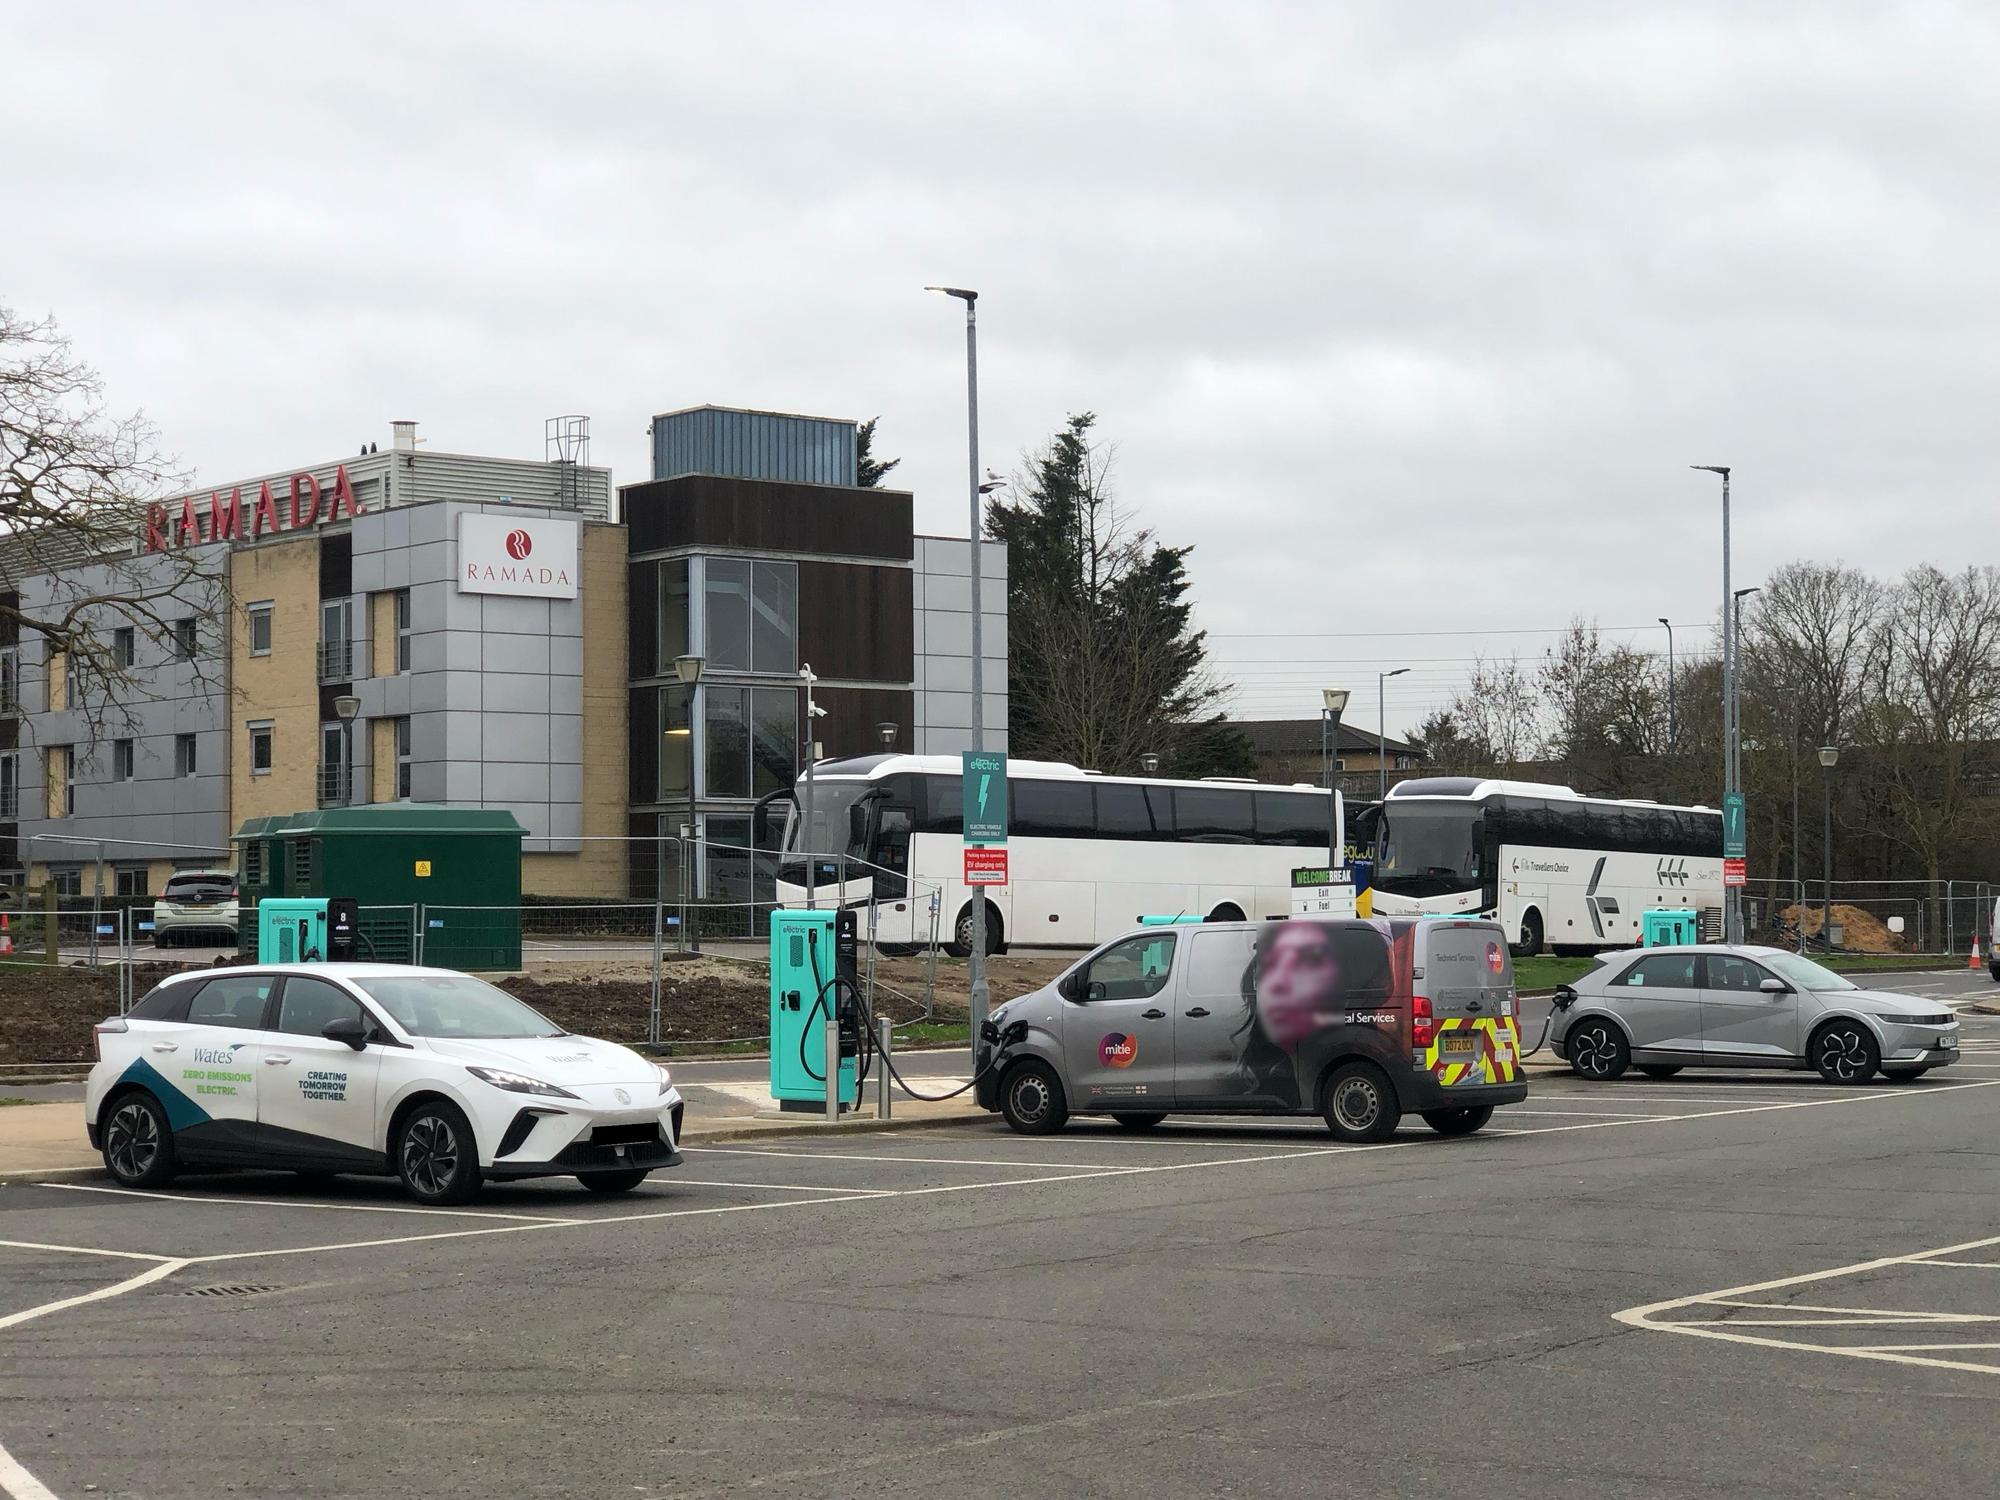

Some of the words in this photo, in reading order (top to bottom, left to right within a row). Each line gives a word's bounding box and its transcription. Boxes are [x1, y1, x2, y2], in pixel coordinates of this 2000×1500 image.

[147, 464, 357, 551] RAMADA
[467, 563, 568, 585] RAMADA
[970, 757, 1000, 770] electric
[1530, 861, 1554, 871] Travellers
[1554, 862, 1569, 872] Choice
[1296, 870, 1351, 884] WELCOMEBREAK
[1319, 888, 1329, 897] Exit
[1319, 901, 1330, 910] Fuel
[782, 925, 806, 934] electric
[1356, 1012, 1396, 1023] Services
[1105, 1043, 1131, 1055] mitie
[194, 1048, 233, 1064] Wates
[183, 1070, 205, 1079] ZERO
[207, 1071, 252, 1082] EMISSIONS
[308, 1071, 347, 1081] CREATING
[196, 1084, 238, 1096] ELECTRIC.
[298, 1080, 346, 1091] TOMORROW
[302, 1090, 346, 1101] TOGETHER.
